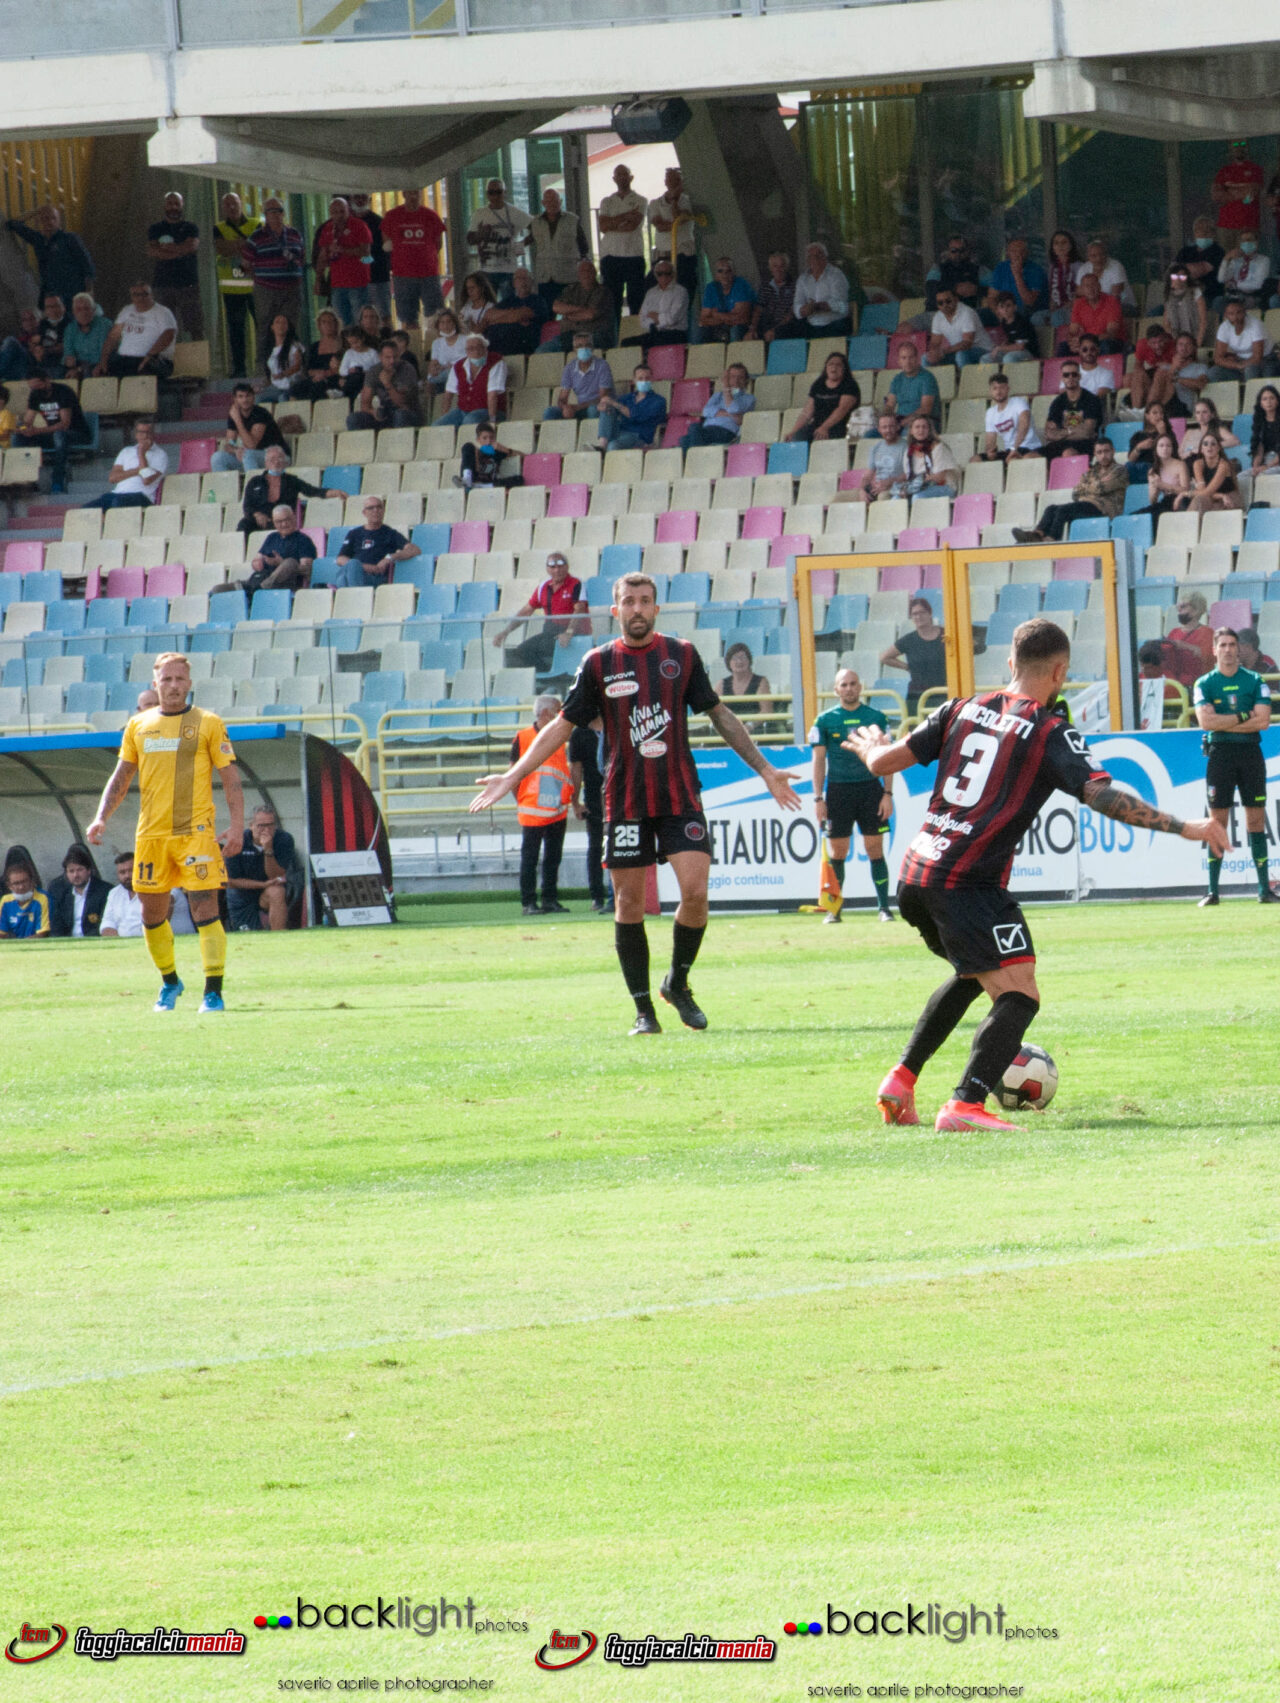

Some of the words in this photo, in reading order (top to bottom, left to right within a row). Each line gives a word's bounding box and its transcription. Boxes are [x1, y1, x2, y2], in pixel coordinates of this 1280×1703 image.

[628, 704, 653, 728] VIVA
[652, 701, 662, 714] LA
[957, 702, 1035, 740] NICOLETTI
[629, 709, 672, 748] MAMMA
[942, 732, 1000, 808] 3
[614, 825, 640, 847] 25
[138, 861, 154, 881] 11
[734, 873, 785, 886] continua
